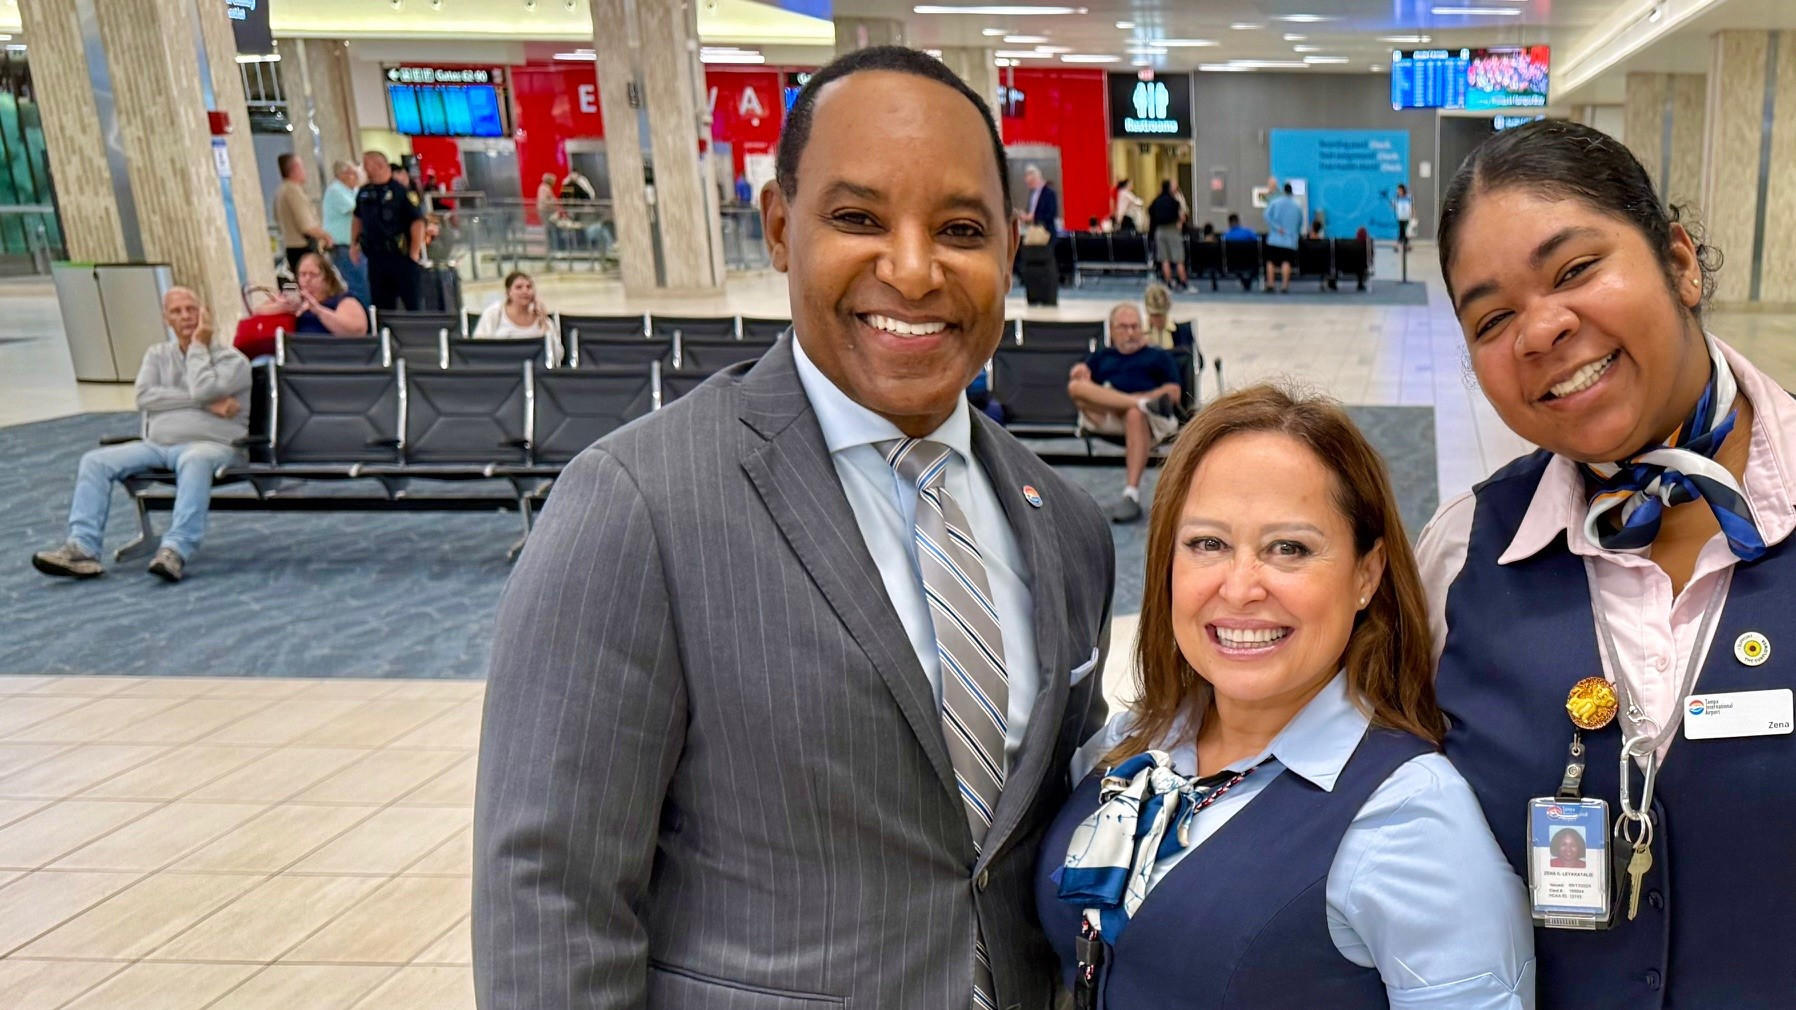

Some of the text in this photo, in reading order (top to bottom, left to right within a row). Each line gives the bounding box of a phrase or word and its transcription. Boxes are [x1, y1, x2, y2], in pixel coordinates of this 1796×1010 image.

[1124, 117, 1178, 133] Restrooms
[1737, 634, 1753, 648] SUPPORT
[1754, 639, 1768, 663] SUNFLOWER
[1768, 721, 1790, 729] Zena
